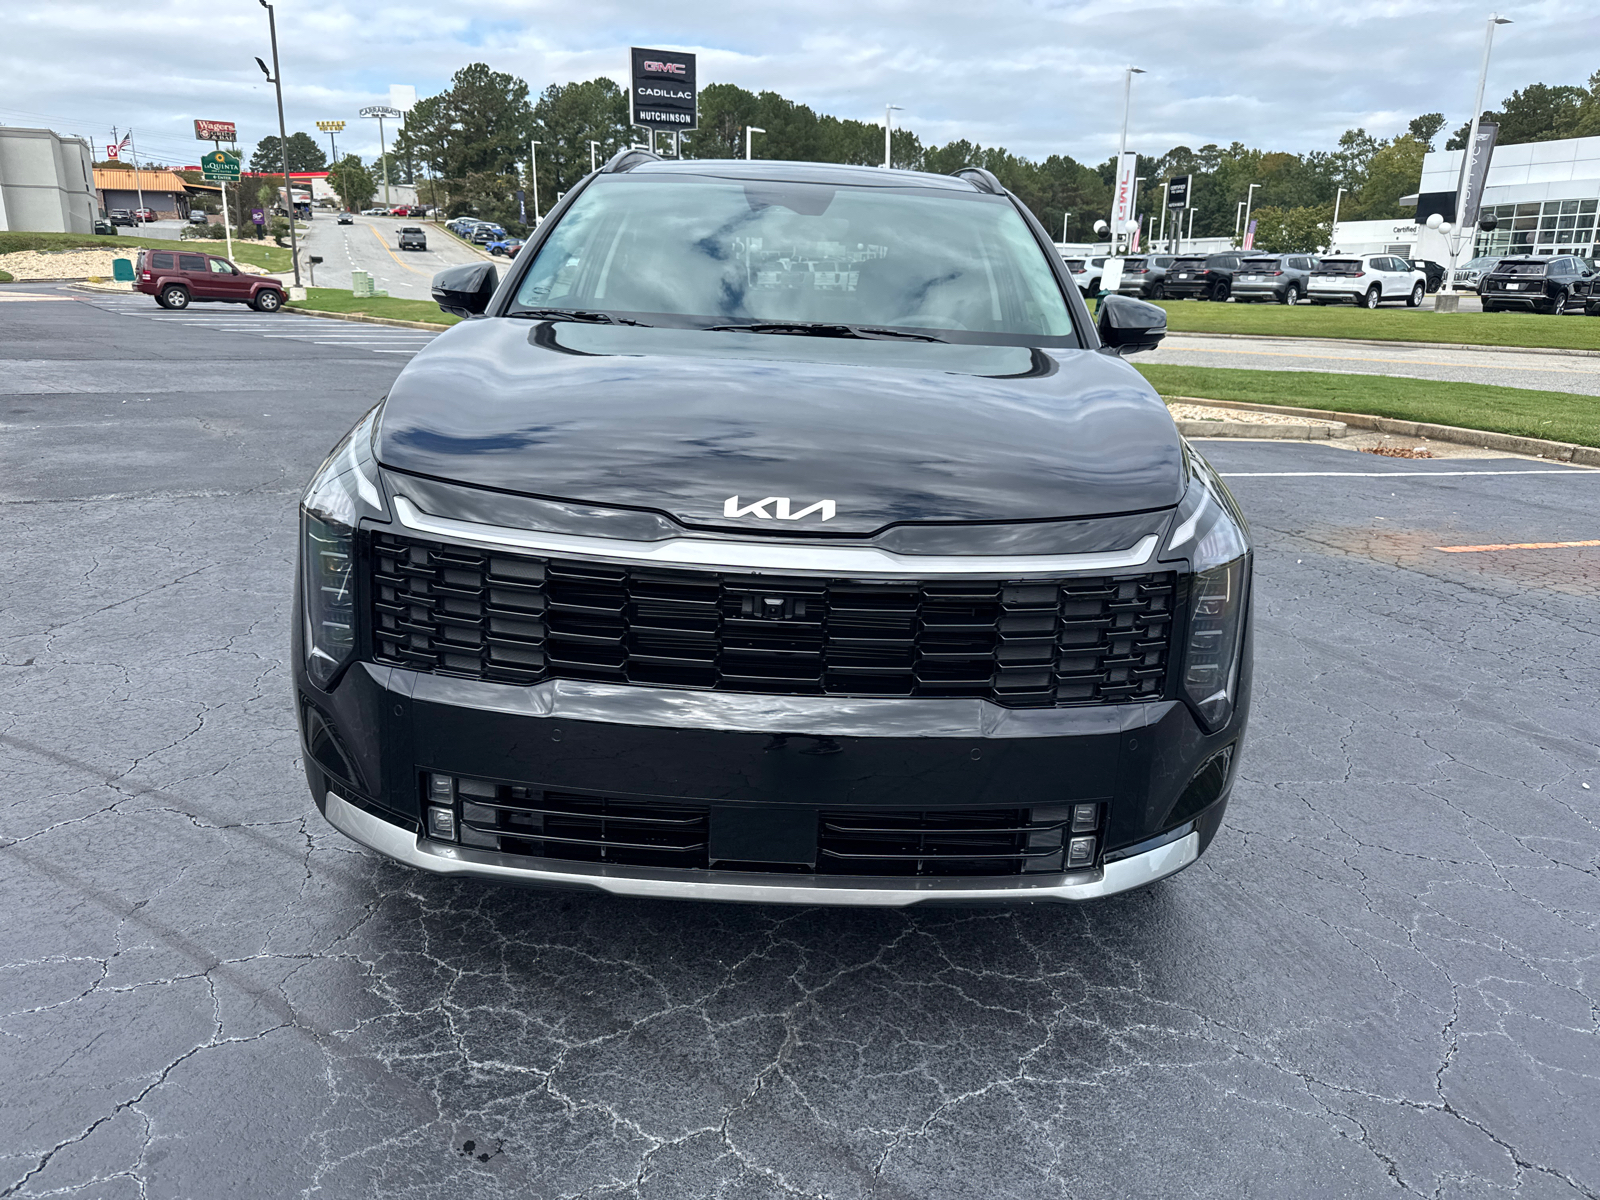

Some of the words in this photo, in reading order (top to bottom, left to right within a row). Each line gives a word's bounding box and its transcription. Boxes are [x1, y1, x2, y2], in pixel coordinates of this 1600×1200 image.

[644, 61, 685, 74] GMC
[638, 87, 692, 99] CADILLAC
[640, 111, 691, 123] HUTCHINSON
[198, 120, 234, 131] Wagers
[723, 494, 836, 522] KIA
